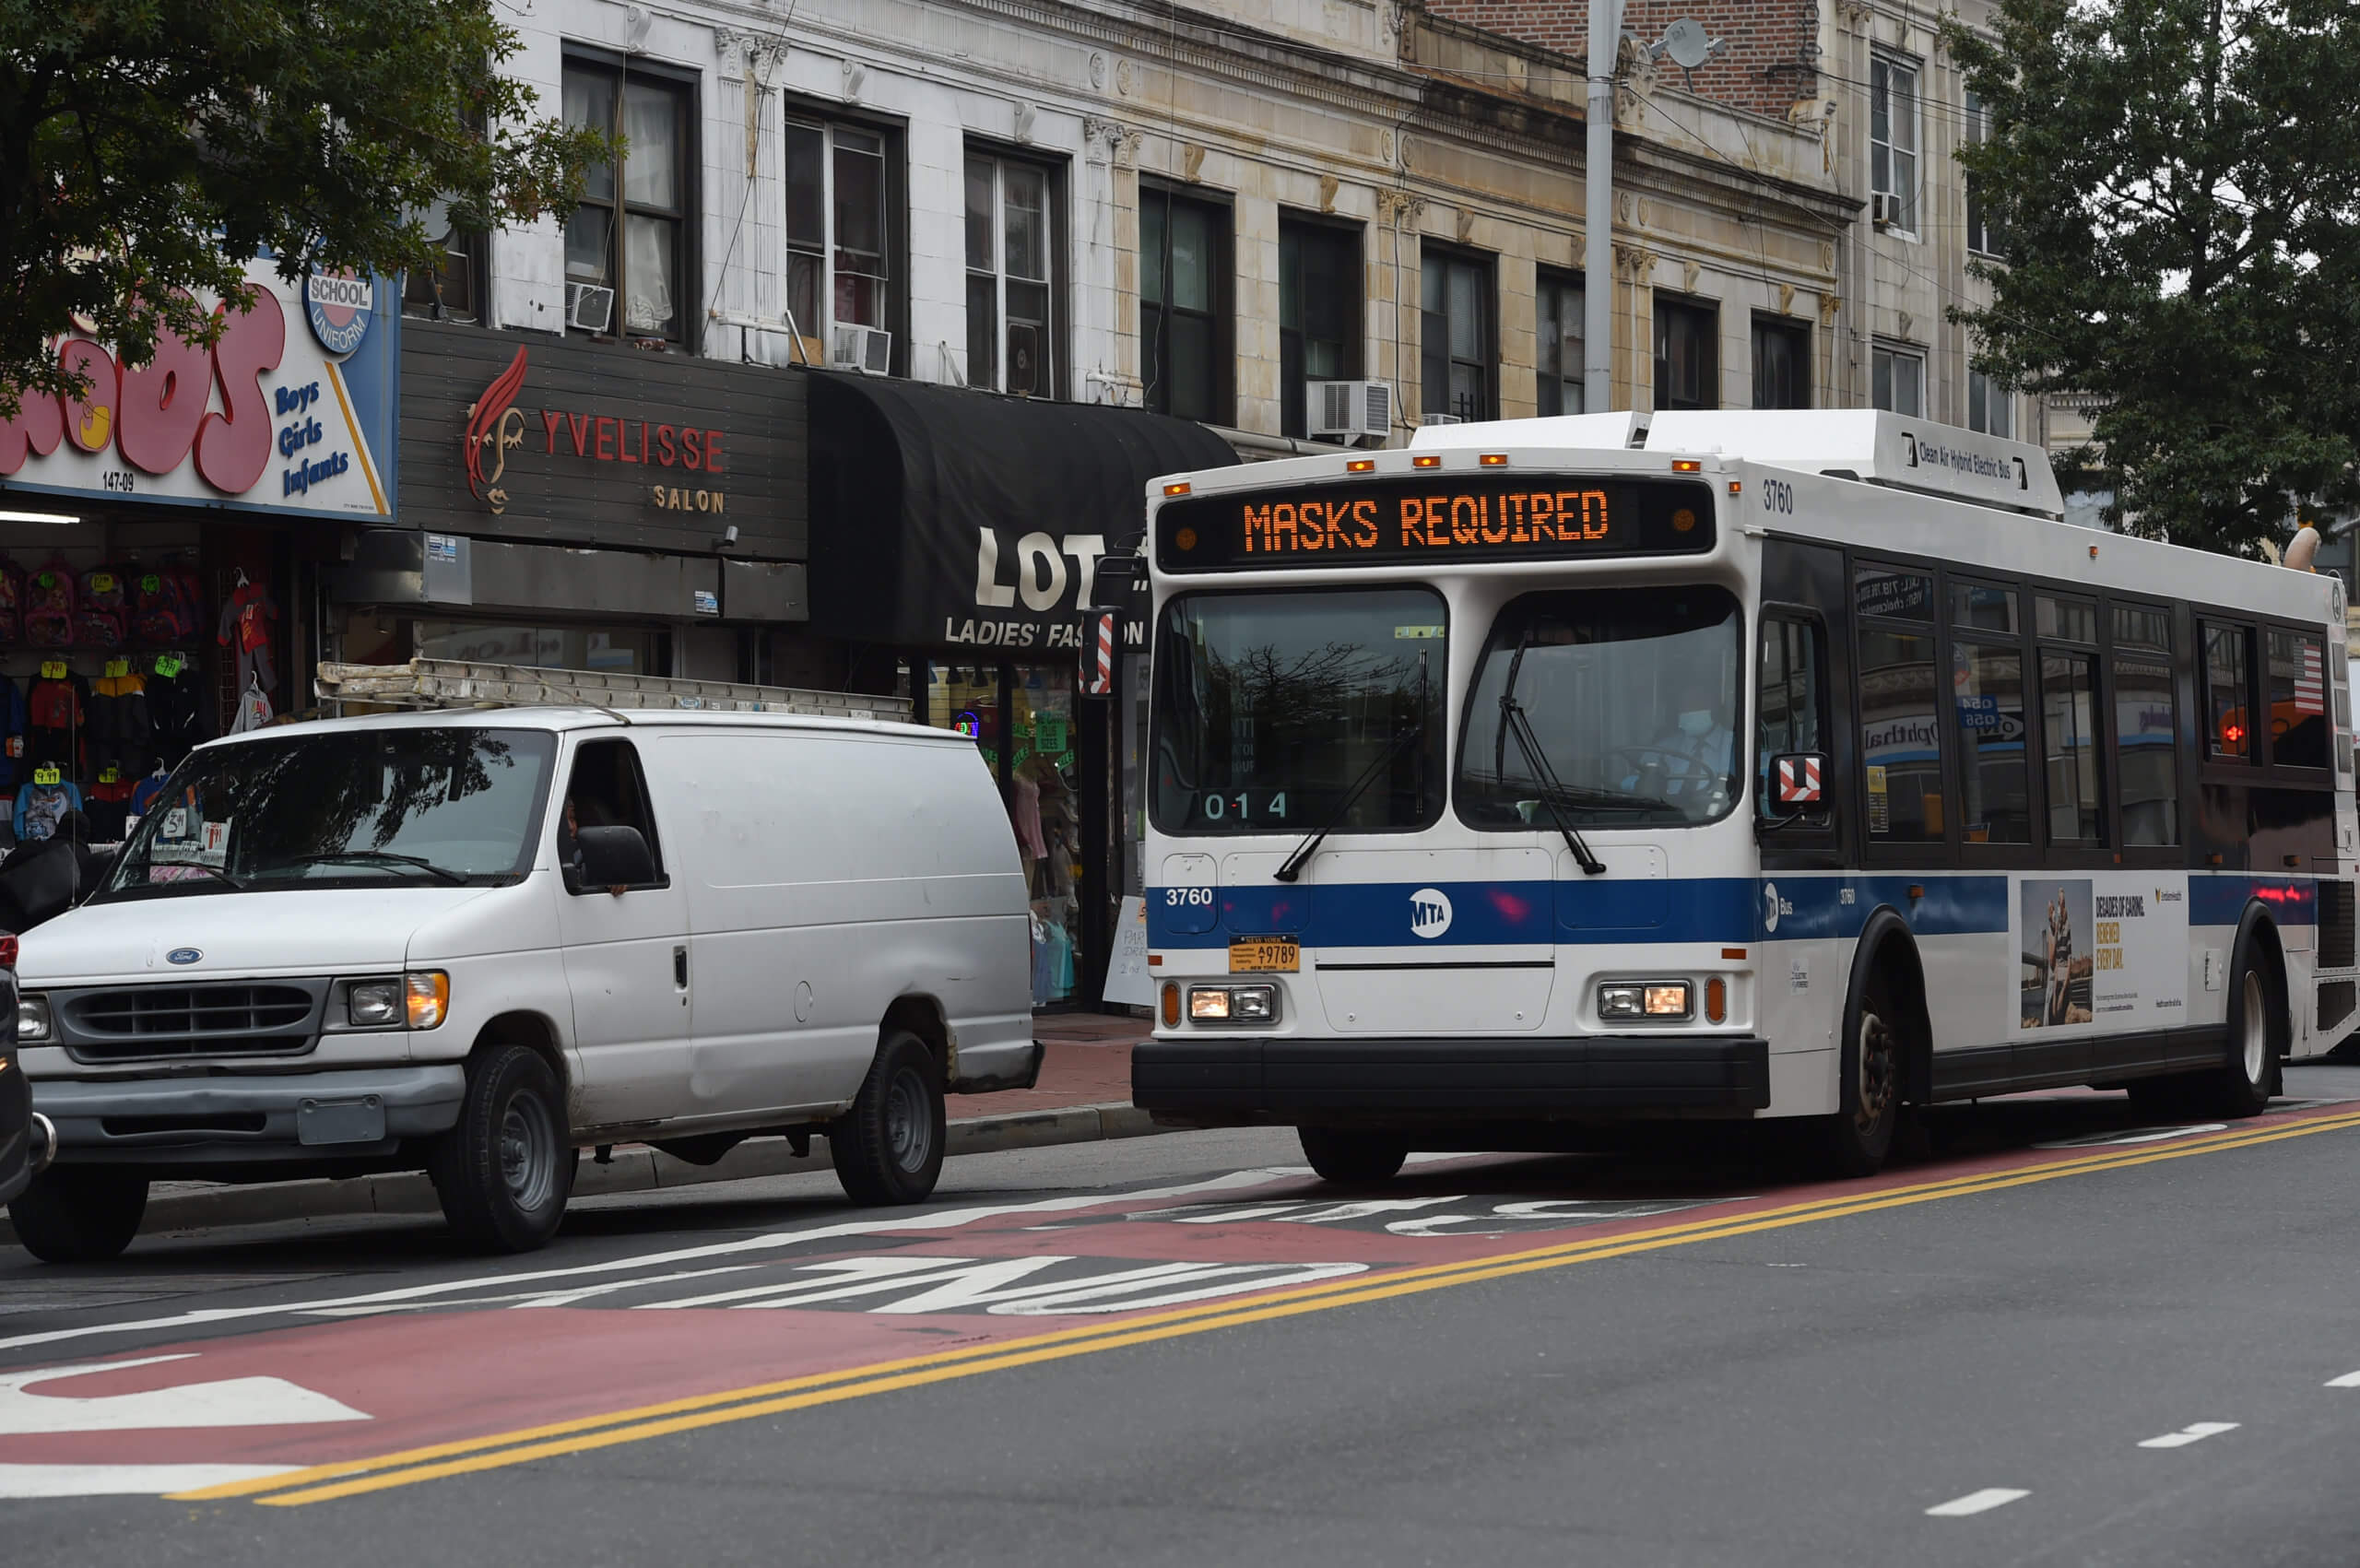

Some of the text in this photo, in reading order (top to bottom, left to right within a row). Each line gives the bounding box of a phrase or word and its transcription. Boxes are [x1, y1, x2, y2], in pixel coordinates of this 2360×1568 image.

[312, 278, 368, 306] SCHOOL
[313, 308, 366, 348] UNIFORM
[276, 379, 319, 416] Boys
[279, 417, 323, 456] Girls
[540, 409, 724, 473] YVELISSE
[284, 451, 348, 497] Infants
[1919, 442, 2011, 479] Clean Air Hybrid Electric Bus
[102, 472, 135, 492] 147-09
[1764, 478, 1793, 514] 3760
[654, 485, 724, 513] SALON
[1244, 489, 1609, 552] MASKS REQUIRED
[975, 525, 1106, 612] LOT
[945, 617, 1040, 647] LADIES'
[1166, 888, 1212, 905] 3760
[1779, 897, 1793, 914] Bus
[1839, 888, 1856, 905] 3760
[2095, 896, 2118, 918] DECADES
[2118, 896, 2125, 918] OF
[1409, 900, 1446, 927] MTA
[2095, 922, 2119, 944] RENEWED
[2095, 948, 2112, 971] EVERY
